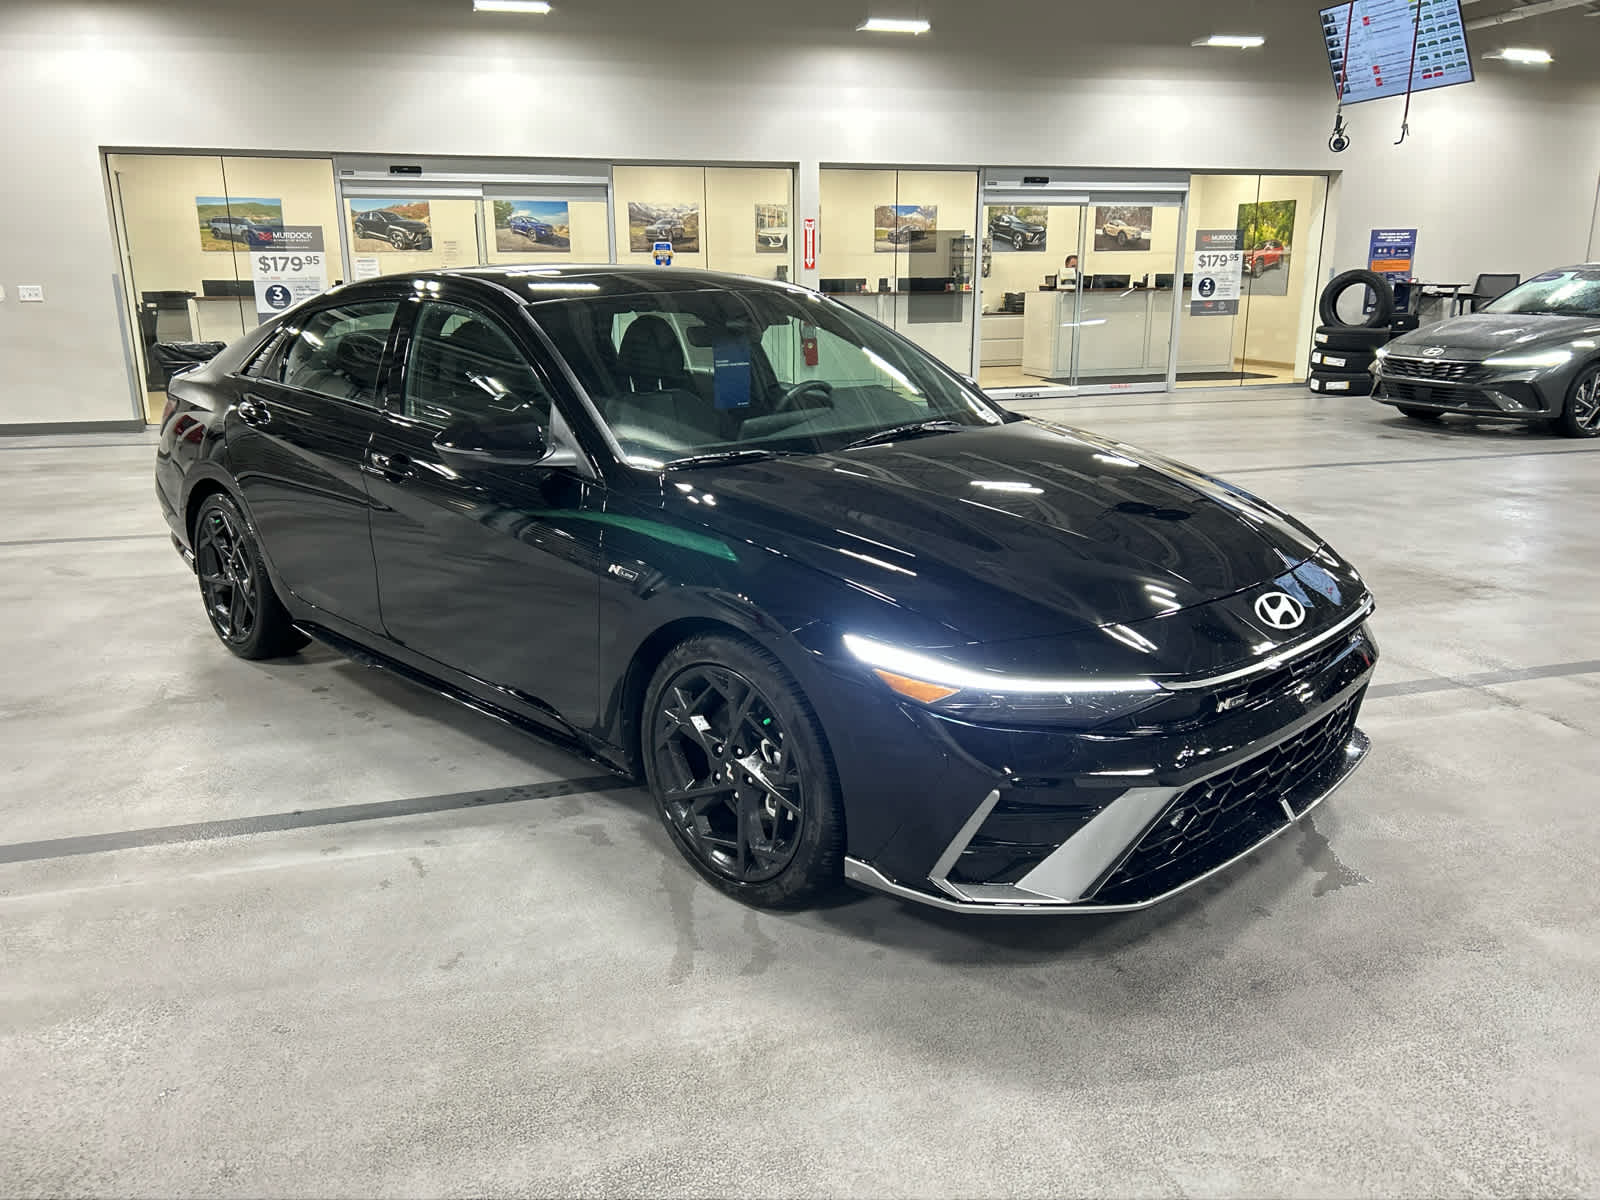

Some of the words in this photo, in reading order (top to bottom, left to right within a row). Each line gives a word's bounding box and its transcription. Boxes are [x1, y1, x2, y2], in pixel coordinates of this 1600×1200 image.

[272, 231, 313, 239] MURDOCK
[1203, 279, 1211, 290] 3
[272, 286, 283, 300] 3
